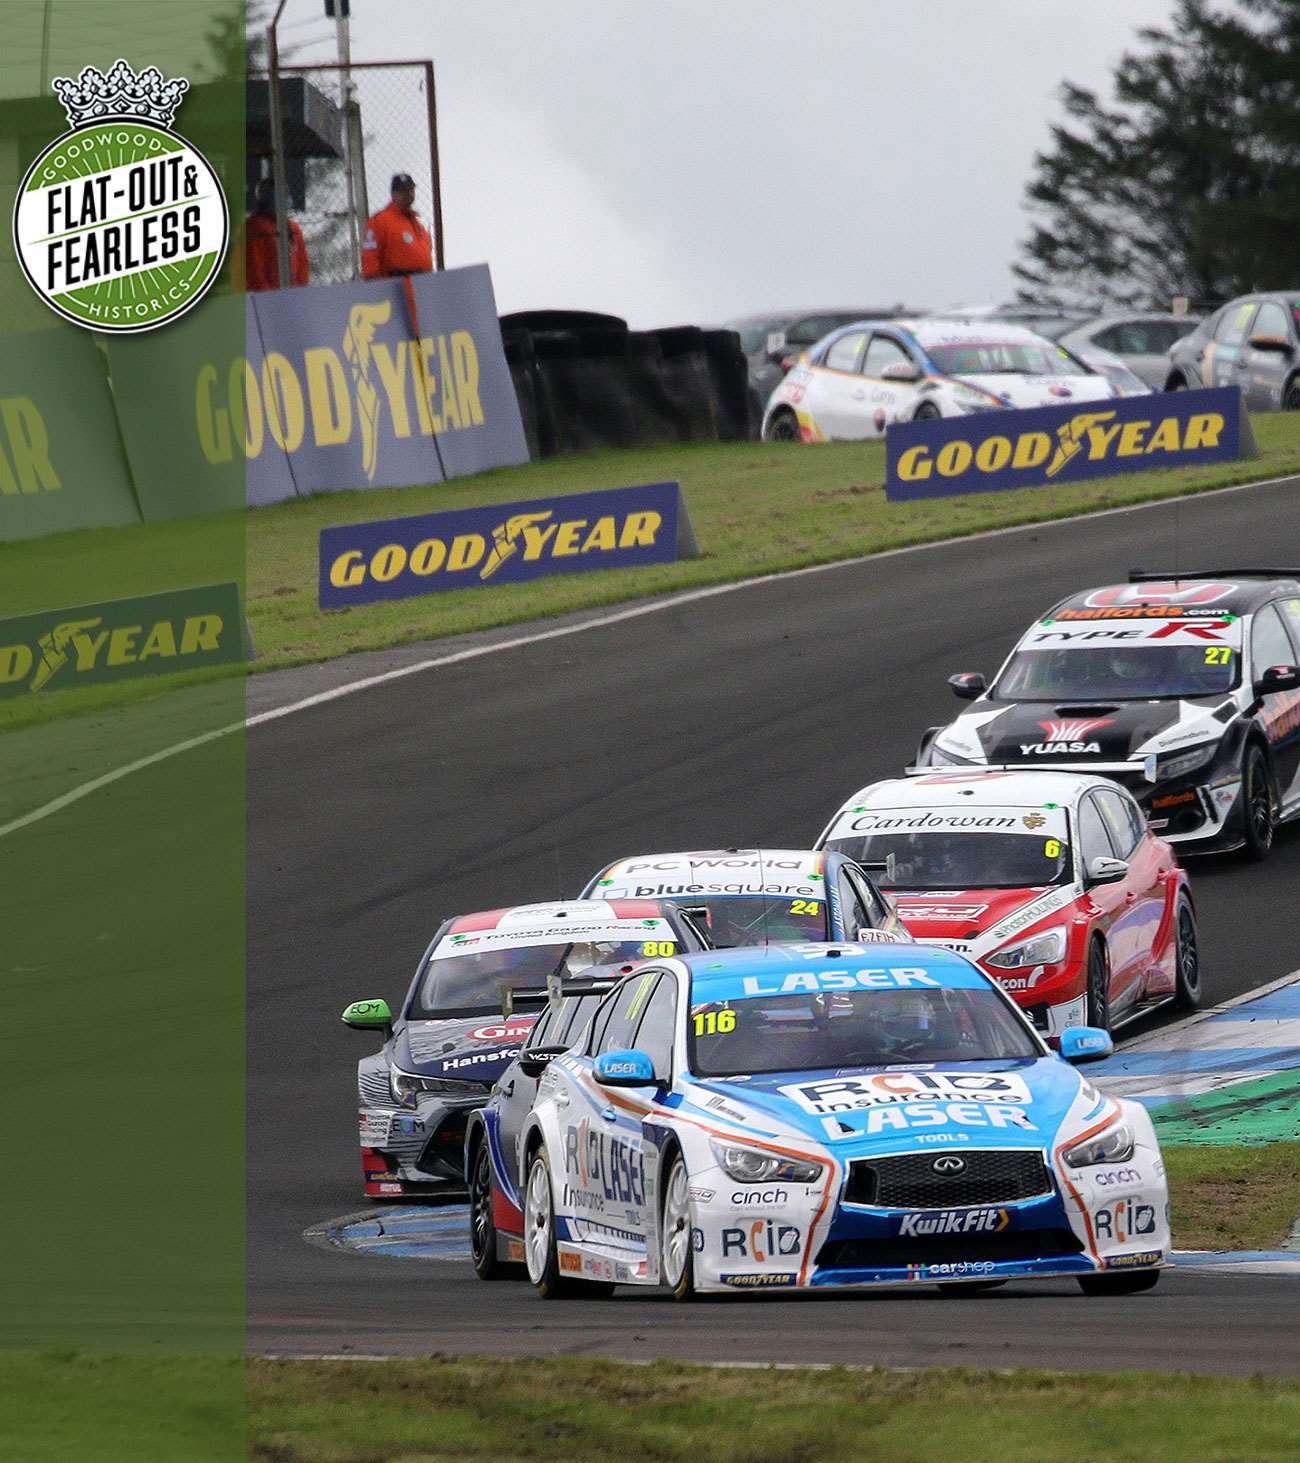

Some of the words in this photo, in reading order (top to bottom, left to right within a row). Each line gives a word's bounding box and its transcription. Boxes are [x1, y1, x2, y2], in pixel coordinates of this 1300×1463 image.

[195, 331, 484, 465] GOODYEAR
[897, 412, 1225, 482] GOODYEAR
[330, 511, 661, 587] GOODYEAR
[1033, 630, 1144, 642] TYPE
[1145, 621, 1233, 640] R
[1204, 647, 1233, 665] 27
[1019, 742, 1101, 755] YUASA
[850, 812, 1017, 833] Cardowan
[1044, 839, 1061, 860] 6
[626, 859, 687, 874] PC
[692, 856, 803, 871] World
[635, 881, 815, 897] bluesquare
[789, 900, 820, 916] 24
[642, 942, 676, 958] 80
[742, 967, 942, 995] LASER
[693, 1009, 736, 1037] 116
[604, 1062, 638, 1074] LASER
[821, 1103, 1040, 1141] LASER
[915, 1133, 970, 1145] TOOLS
[1095, 1168, 1142, 1187] cinch
[731, 1188, 788, 1205] cinch
[929, 1261, 995, 1274] carshop
